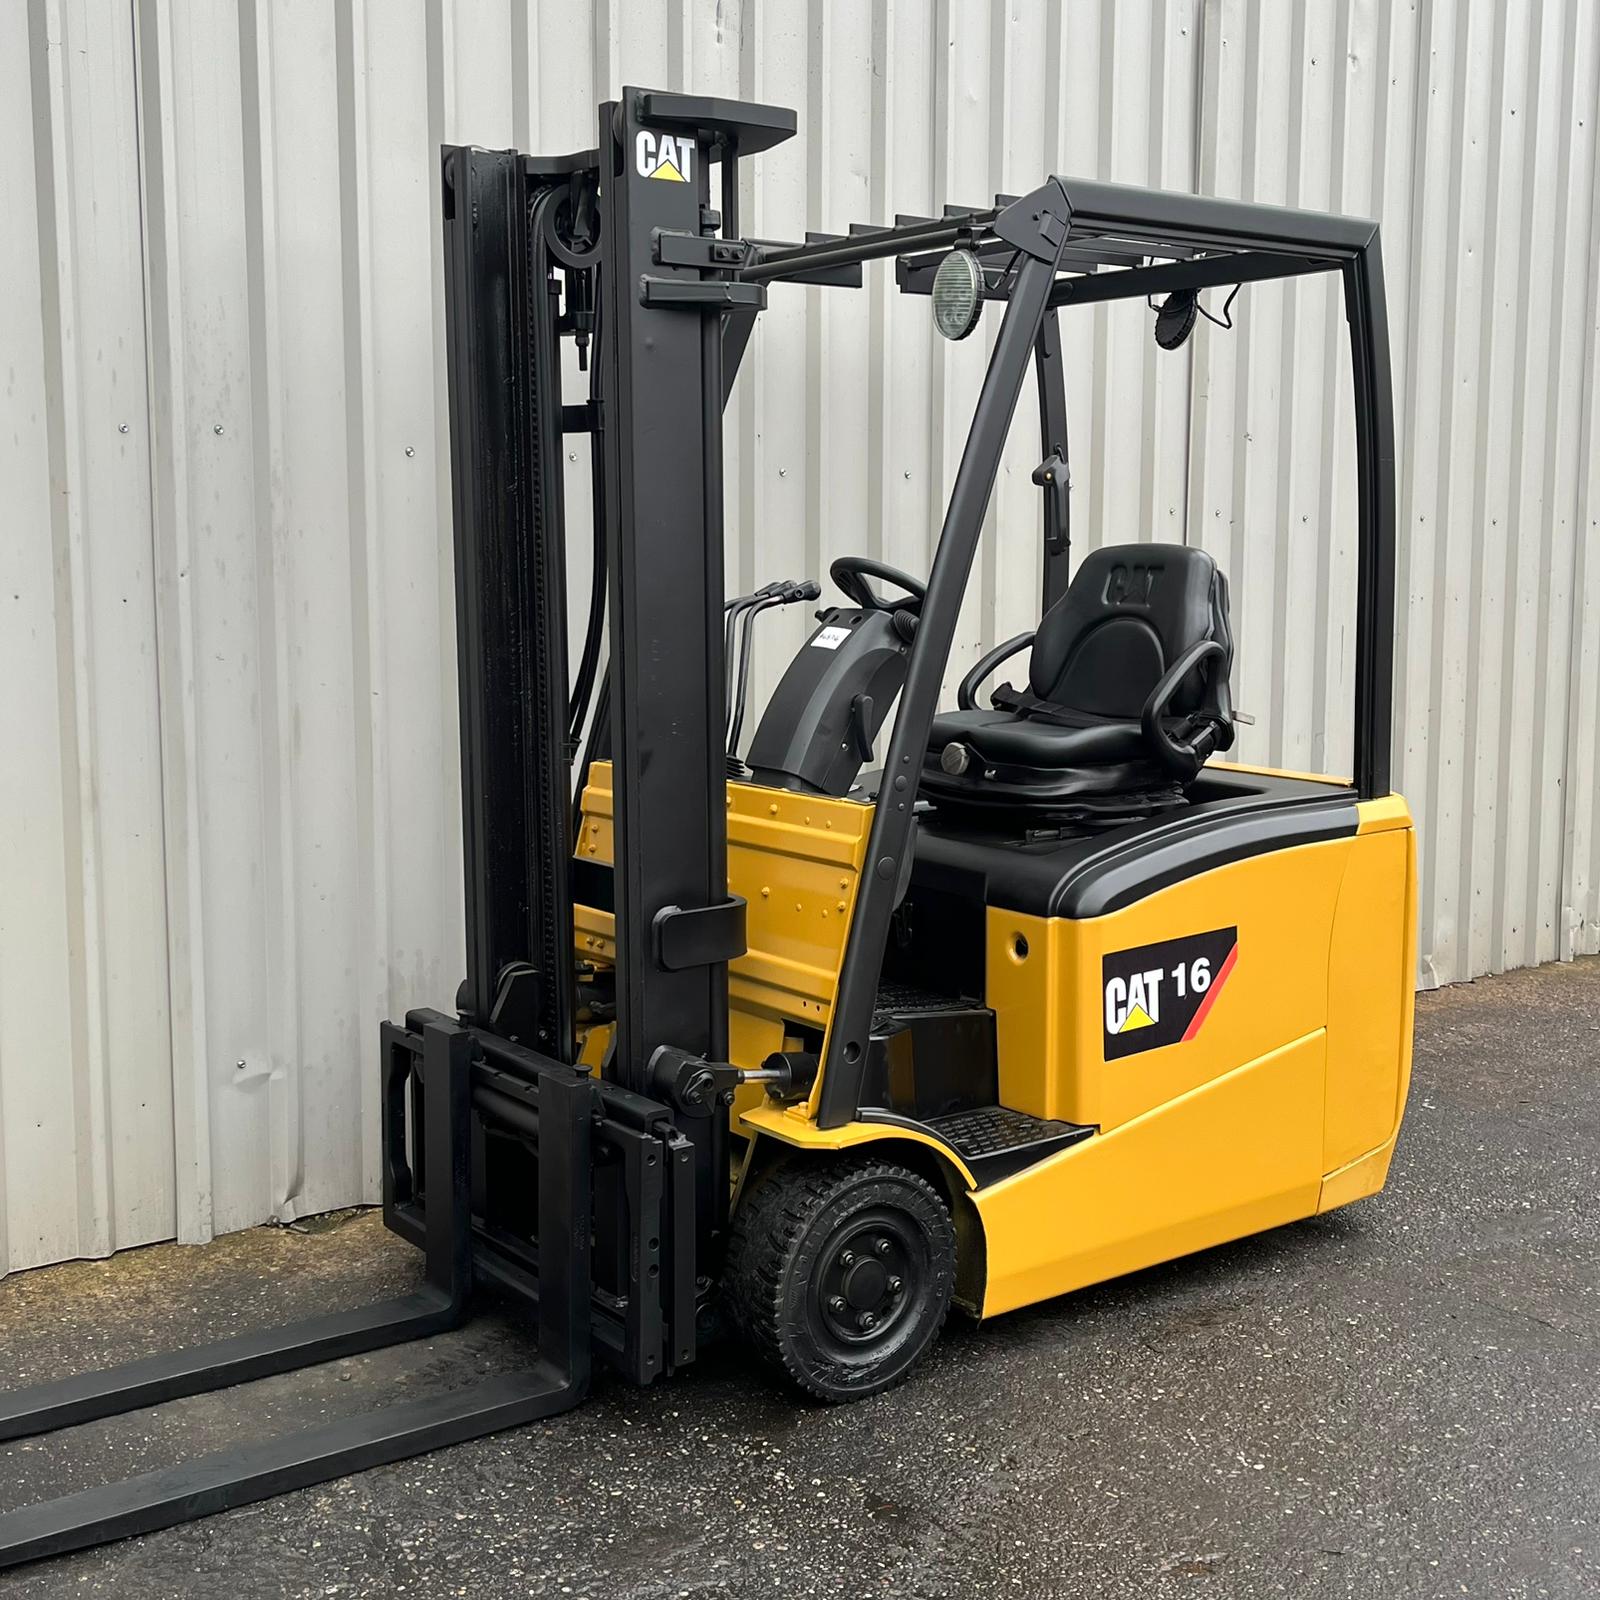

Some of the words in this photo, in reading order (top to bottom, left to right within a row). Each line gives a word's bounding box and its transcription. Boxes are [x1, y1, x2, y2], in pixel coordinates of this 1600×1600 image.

[635, 130, 695, 183] CAT
[1101, 563, 1166, 609] CAT
[1105, 967, 1164, 1035] CAT
[1171, 957, 1211, 997] 16
